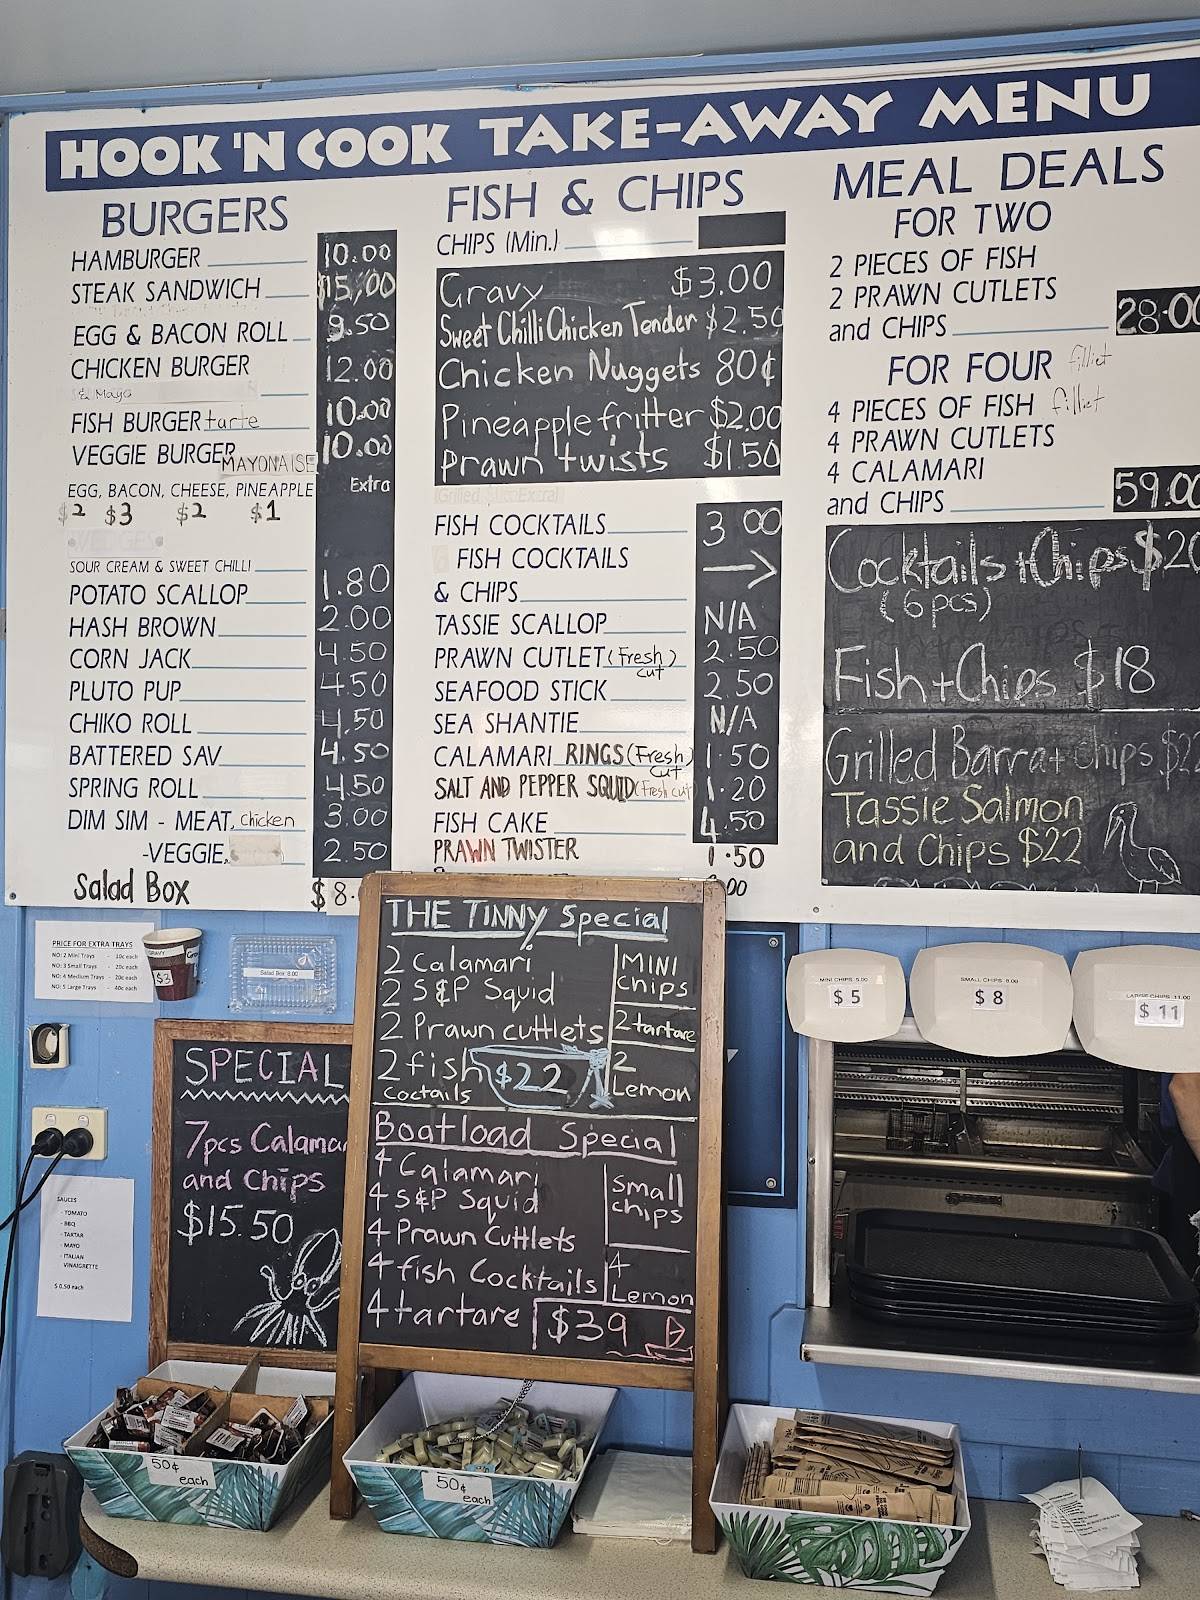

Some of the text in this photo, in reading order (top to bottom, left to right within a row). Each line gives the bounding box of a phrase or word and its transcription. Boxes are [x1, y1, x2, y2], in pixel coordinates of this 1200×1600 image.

[59, 72, 1151, 180] HOOK 'N COOK TAKE-AWAY MENU
[833, 143, 1164, 200] MEAL DEALS
[447, 169, 744, 223] FISH & CHIPS
[101, 195, 288, 238] BURGERS
[894, 200, 1051, 239] FOR TWO
[325, 242, 391, 268] 10.00
[437, 229, 559, 256] CHIPS (Min.)
[71, 247, 201, 272] HAMBURGER
[829, 245, 1036, 278] 2 PIECES OF FISH
[71, 277, 261, 304] STEAK SANDWICH
[439, 260, 772, 312] Gravy $3.00
[829, 276, 1057, 309] 2 PRAWN CUTLETS
[73, 321, 288, 347] EGG & BACON ROLL
[439, 312, 493, 349] Sweet
[497, 308, 543, 347] Chilli
[547, 305, 623, 341] Chicken
[705, 304, 784, 340] $2.50
[71, 355, 250, 380] CHICKEN BURGER
[326, 355, 393, 383] 12.00
[438, 351, 574, 390] Chicken
[588, 348, 701, 393] Nuggets
[888, 350, 1052, 386] FOR FOUR
[71, 410, 201, 434] FISH BURGER
[326, 396, 391, 427] 10.00
[441, 403, 593, 457] Pineapple
[709, 395, 783, 433] $2.00
[71, 442, 237, 467] VEGGIE BURGER
[827, 457, 984, 484] 4 CALAMARI
[68, 482, 313, 500] EGG, BACON, CHEESE, PINEAPPLE
[350, 479, 391, 494] Extra
[434, 513, 606, 536] FISH COCKTAILS
[69, 560, 251, 573] SOUR CREAM & SWEET CHILLI
[457, 547, 629, 569] FISH COCKTAILS
[69, 583, 248, 606] POTATO SCALLOP
[323, 564, 391, 600] 1.80
[69, 616, 216, 638] HASH BROWN
[317, 604, 392, 632] 2.00
[434, 612, 607, 635] TASSIE SCALLOP
[704, 600, 756, 634] N/A
[69, 648, 192, 670] CORN JACK
[434, 646, 607, 669] PRAWN CUTLET
[69, 681, 181, 702] PLUTO PUP
[434, 679, 607, 702] SEAFOOD STICK
[69, 713, 192, 734] CHIKO ROLL
[69, 745, 222, 767] BATTERED SAV
[434, 745, 551, 767] CALAMARI
[434, 774, 636, 802] SALT AND PEPPER SQUID
[830, 783, 1084, 828] Tassie Salmon
[433, 811, 548, 833] FISH CAKE
[434, 837, 580, 864] PRAWN TWISTER
[832, 834, 904, 866] and
[1018, 826, 1083, 868] $22
[74, 868, 190, 906] Salad Box
[385, 899, 452, 930] THE
[560, 904, 669, 946] Special
[383, 945, 678, 976] 2 Calamari MINI
[185, 1047, 344, 1089] SPECIAL
[495, 1061, 568, 1095] $22
[612, 1076, 691, 1102] Lemon
[375, 1110, 676, 1159] Boatload Special
[182, 1168, 233, 1191] and
[374, 1147, 539, 1187] 4 Calamari
[177, 1200, 294, 1246] $15.50
[367, 1288, 520, 1328] 4 tartare
[547, 1305, 627, 1347] $39
[179, 1475, 209, 1487] each
[463, 1494, 491, 1505] each
